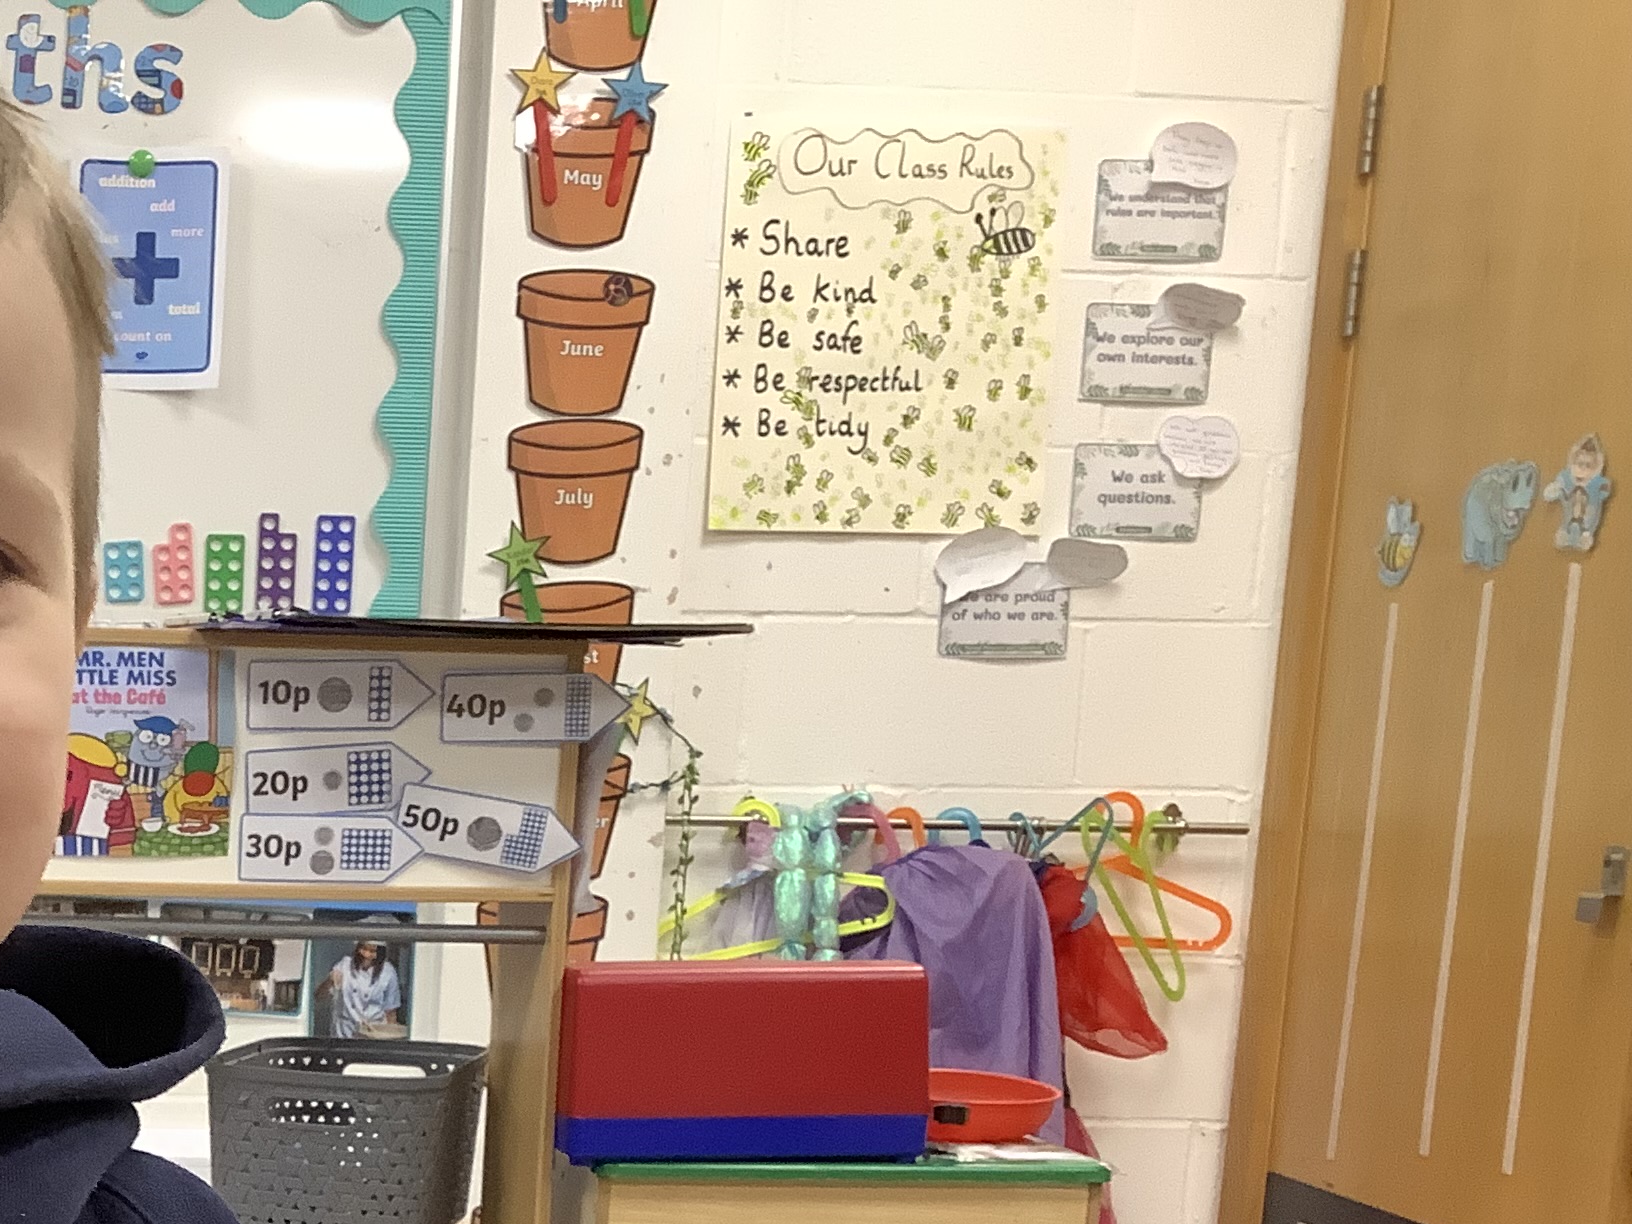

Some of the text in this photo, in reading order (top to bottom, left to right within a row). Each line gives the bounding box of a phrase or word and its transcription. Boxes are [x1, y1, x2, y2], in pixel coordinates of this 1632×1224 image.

[793, 134, 1015, 180] Our Class Rules
[98, 174, 156, 189] addition
[563, 169, 603, 191] May
[149, 199, 176, 213] add
[1108, 193, 1125, 202] We
[1128, 192, 1191, 203] understand
[1105, 208, 1133, 217] rules
[1136, 209, 1157, 218] are
[170, 227, 205, 238] more
[759, 219, 851, 258] Share
[758, 270, 879, 304] Be kind
[168, 301, 201, 316] total
[155, 332, 173, 342] on
[757, 319, 864, 355] Be safe
[1095, 330, 1205, 347] We explore our
[559, 339, 605, 358] June
[1096, 351, 1198, 366] own interests.
[754, 363, 923, 405] Be respectful
[756, 404, 870, 455] Be tidy
[1110, 469, 1167, 484] We ask
[554, 488, 595, 508] July
[1096, 490, 1177, 506] questions.
[984, 592, 1010, 603] are
[1014, 590, 1056, 606] proud
[951, 608, 969, 621] of
[972, 607, 1002, 621] who
[1007, 610, 1026, 621] we
[116, 650, 165, 668] MEN
[76, 668, 177, 687] TTLE MISS
[71, 687, 166, 705] at the Café
[257, 680, 311, 712] 10p
[446, 692, 506, 725] 40p
[252, 770, 308, 801] 20p
[401, 803, 460, 841] 50p
[245, 834, 302, 866] 30p
